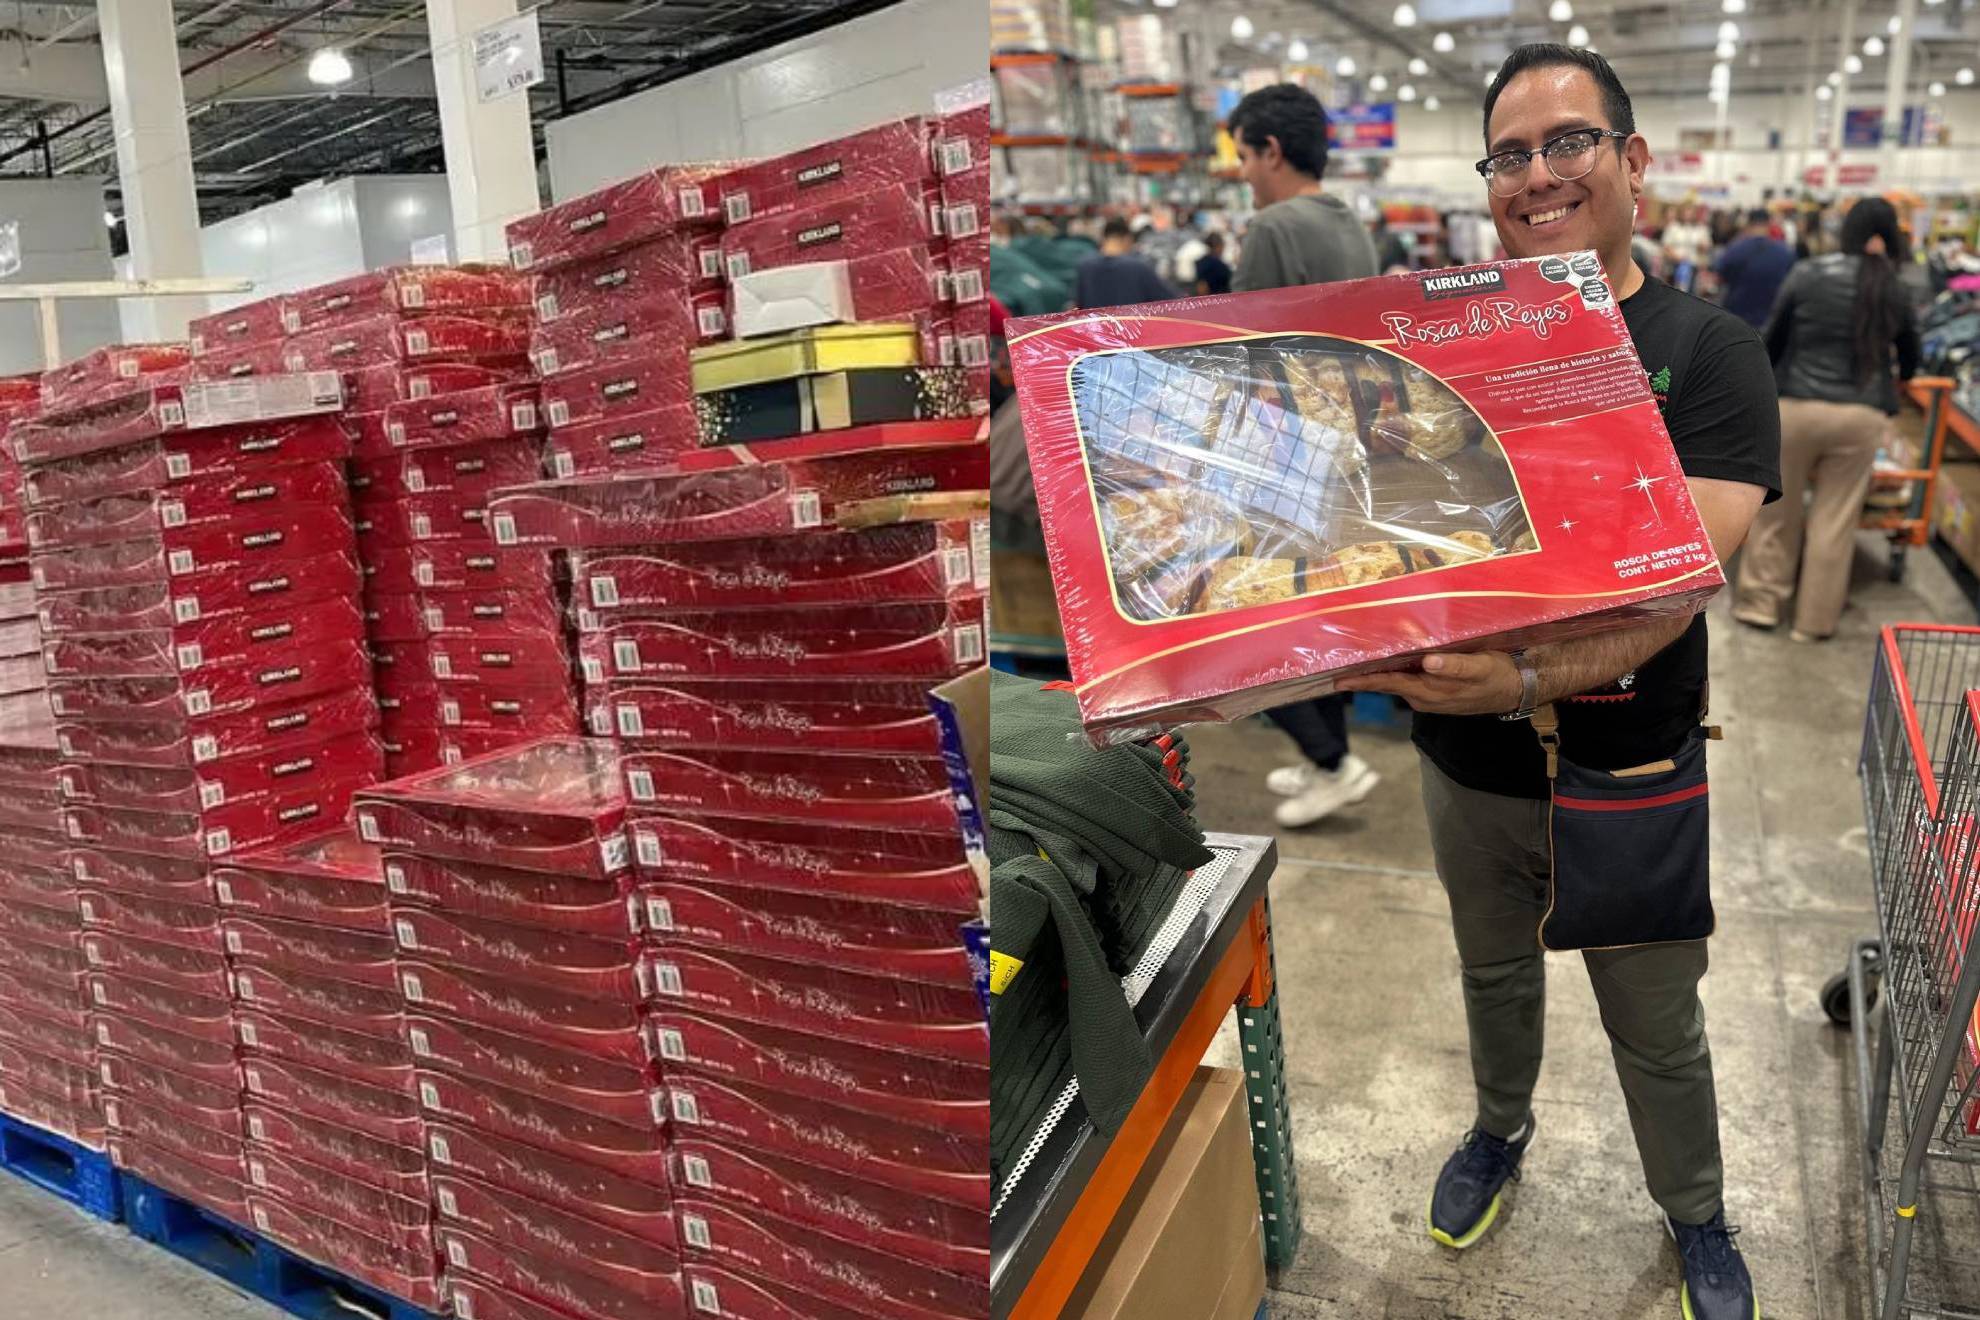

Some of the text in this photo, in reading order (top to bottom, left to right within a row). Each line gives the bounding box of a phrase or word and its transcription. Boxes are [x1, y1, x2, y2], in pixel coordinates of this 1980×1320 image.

[1425, 270, 1500, 292] KIRKLAND
[1388, 301, 1568, 345] Rosca de Reyes
[1485, 374, 1502, 383] Una
[1503, 367, 1538, 380] tradición
[1539, 363, 1559, 375] llena
[1560, 361, 1570, 369] de
[1571, 356, 1600, 367] historia
[1602, 354, 1608, 362] y
[1613, 542, 1702, 569] ROSCA DE REYES
[1618, 553, 1706, 578] CONT. NETO: 2 kg
